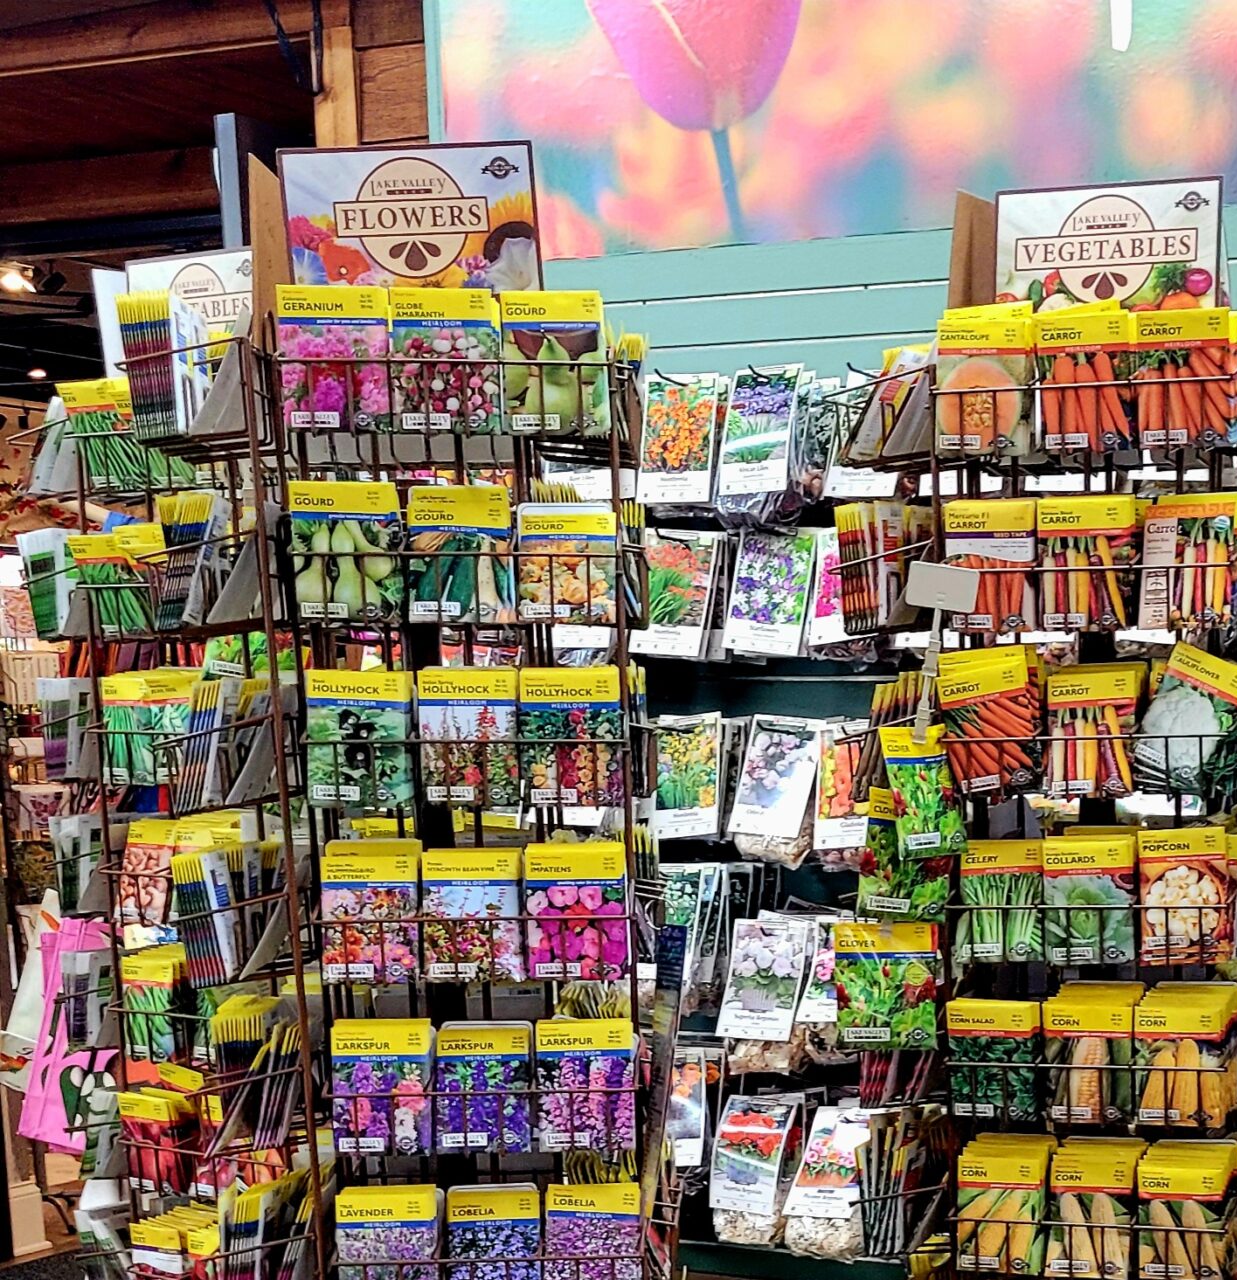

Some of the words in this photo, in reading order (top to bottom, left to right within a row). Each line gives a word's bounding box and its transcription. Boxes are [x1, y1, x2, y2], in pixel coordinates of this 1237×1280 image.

[371, 180, 399, 197] LAKE
[402, 178, 447, 195] VALLEY
[341, 203, 482, 230] FLOWERS
[1072, 216, 1098, 231] LAKE
[1100, 212, 1142, 228] VALLEY
[1022, 235, 1191, 263] VEGETABLES
[192, 296, 250, 318] TABLES
[283, 302, 344, 312] GERANIUM
[506, 307, 546, 316] GOURD
[1140, 326, 1182, 336] CARROT
[940, 333, 990, 341] CANTALOUPE
[1042, 331, 1081, 341] CARROT
[294, 497, 334, 507] GOURD
[1041, 515, 1081, 524] CARROT
[524, 523, 564, 531] GOURD
[949, 521, 986, 530] CARROT
[1146, 522, 1184, 534] Carrot
[1174, 655, 1221, 681] CAULIFLOWER
[312, 684, 380, 695] HOLLYHOCK
[423, 685, 490, 694] HOLLYHOCK
[526, 688, 593, 697] HOLLYHOCK
[942, 683, 980, 697] CARROT
[1051, 687, 1090, 696] CARROT
[886, 744, 910, 753] CLOVER
[1142, 843, 1190, 852] POPCORN
[965, 855, 998, 865] CELERY
[1046, 855, 1096, 865] COLLARDS
[530, 866, 571, 874] IMPATIENS
[839, 939, 876, 949] CLOVER
[1052, 1018, 1080, 1027] CORN
[1139, 1019, 1166, 1027] CORN
[336, 1042, 390, 1050] LARKSPUR
[441, 1042, 494, 1050] LARKSPUR
[540, 1037, 594, 1046] LARKSPUR
[961, 1169, 987, 1177] CORN
[1055, 1173, 1082, 1181] CORN
[1142, 1180, 1170, 1189] CORN
[553, 1198, 596, 1208] LOBELIA
[340, 1209, 394, 1218] LAVENDER
[452, 1208, 495, 1217] LOBELIA
